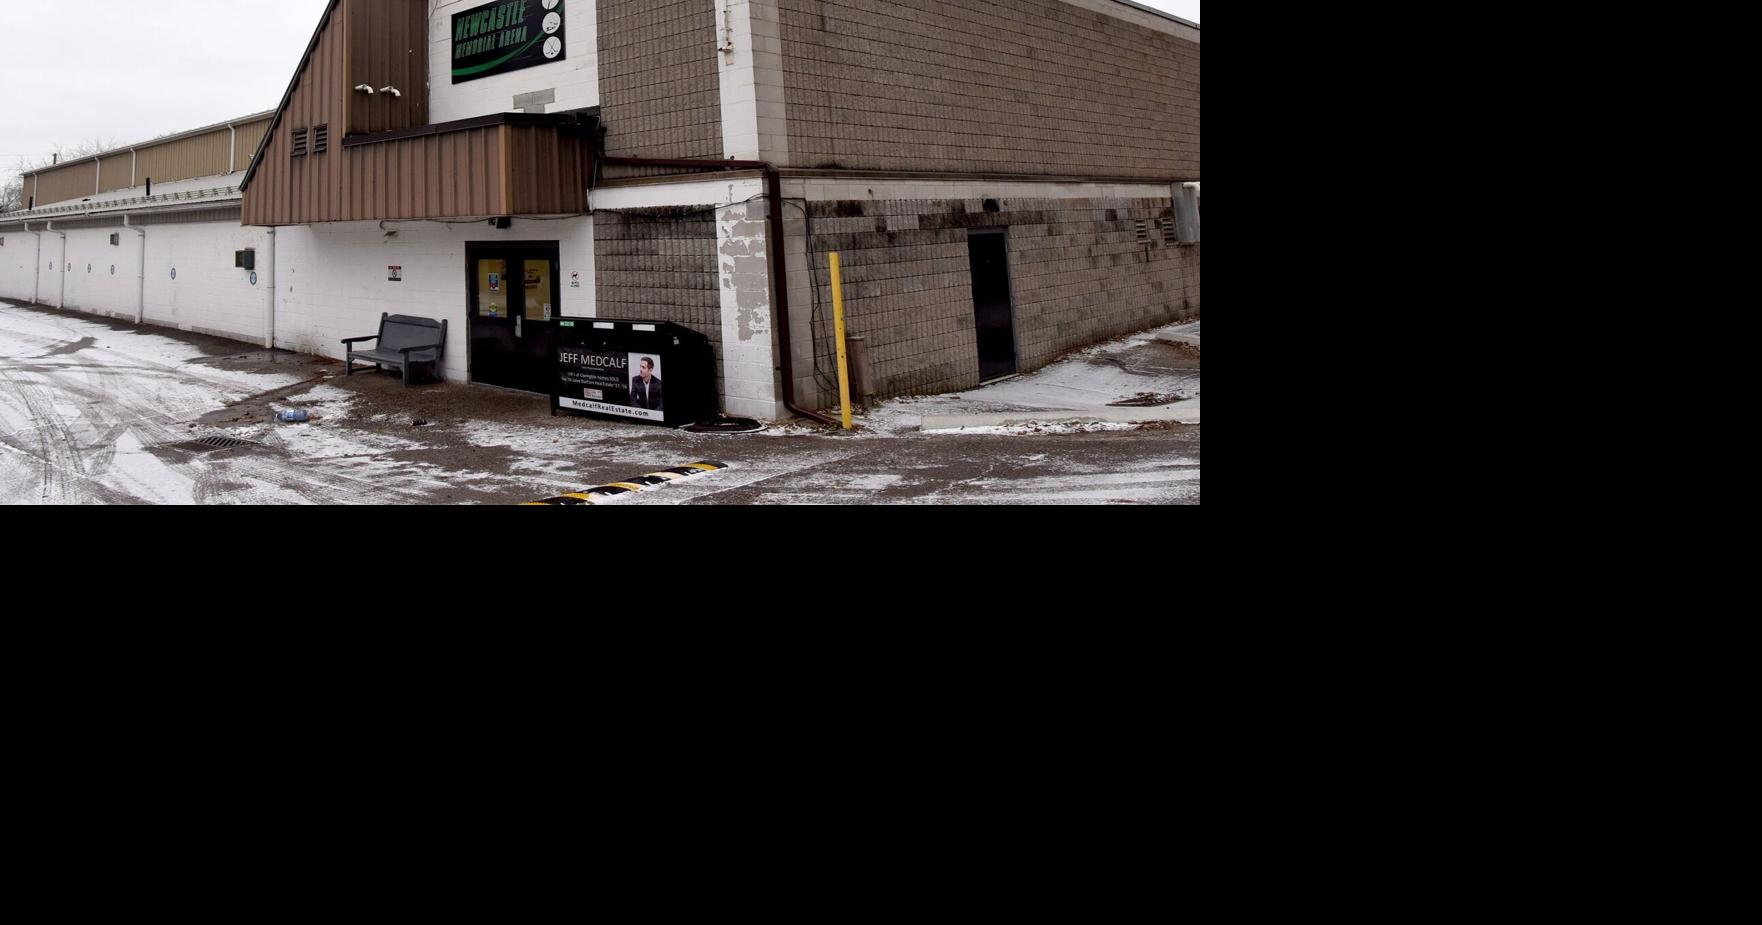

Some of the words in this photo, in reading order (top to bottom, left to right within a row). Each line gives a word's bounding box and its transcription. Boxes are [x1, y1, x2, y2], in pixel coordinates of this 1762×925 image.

[455, 0, 526, 41] NEWCASTLE
[455, 34, 496, 59] MEMORIAL
[498, 26, 527, 48] ARENA
[559, 352, 579, 363] JEFF
[580, 354, 627, 369] MEDCALF
[572, 400, 649, 417] MedcalfRealEstate.com
